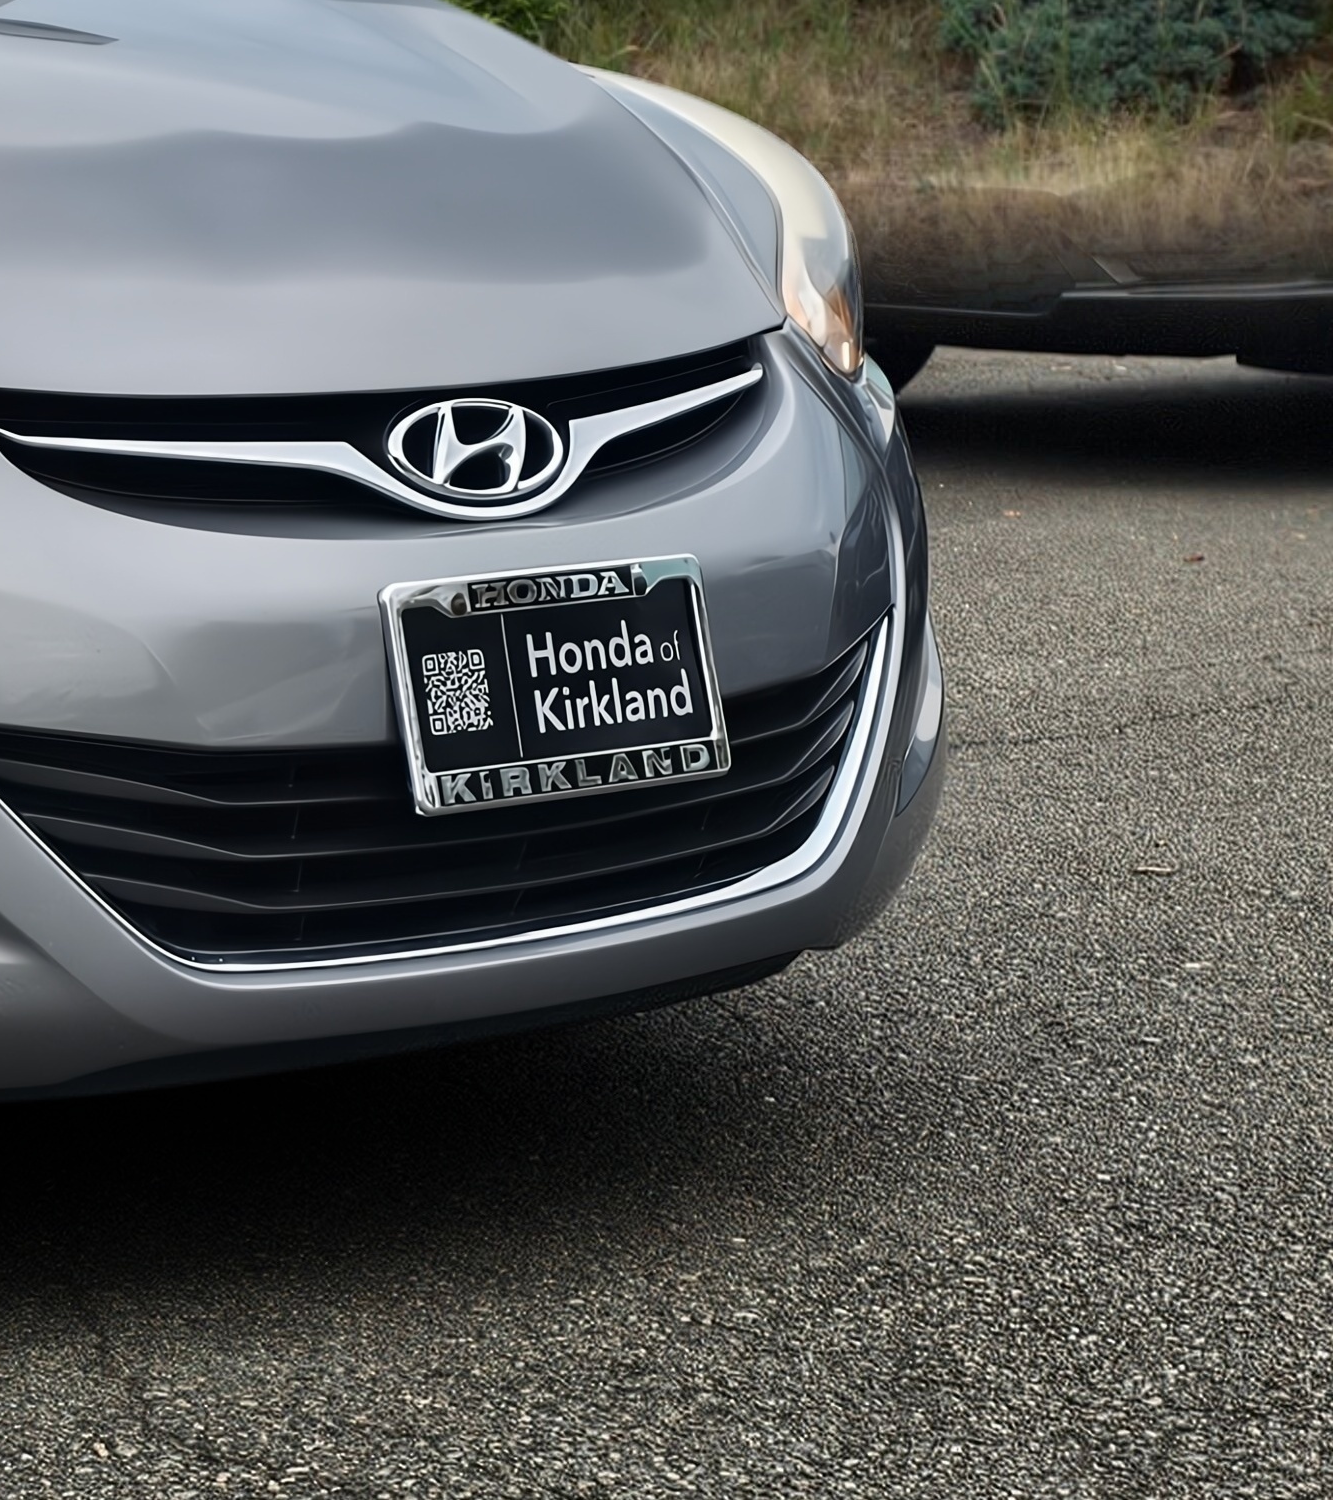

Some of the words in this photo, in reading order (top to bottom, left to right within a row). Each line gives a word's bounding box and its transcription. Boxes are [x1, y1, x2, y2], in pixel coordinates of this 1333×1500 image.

[472, 571, 629, 608] HONDA
[526, 620, 654, 678] Honda
[659, 629, 683, 662] of
[533, 669, 693, 734] Kirkland
[440, 744, 711, 804] KIRKLAND
